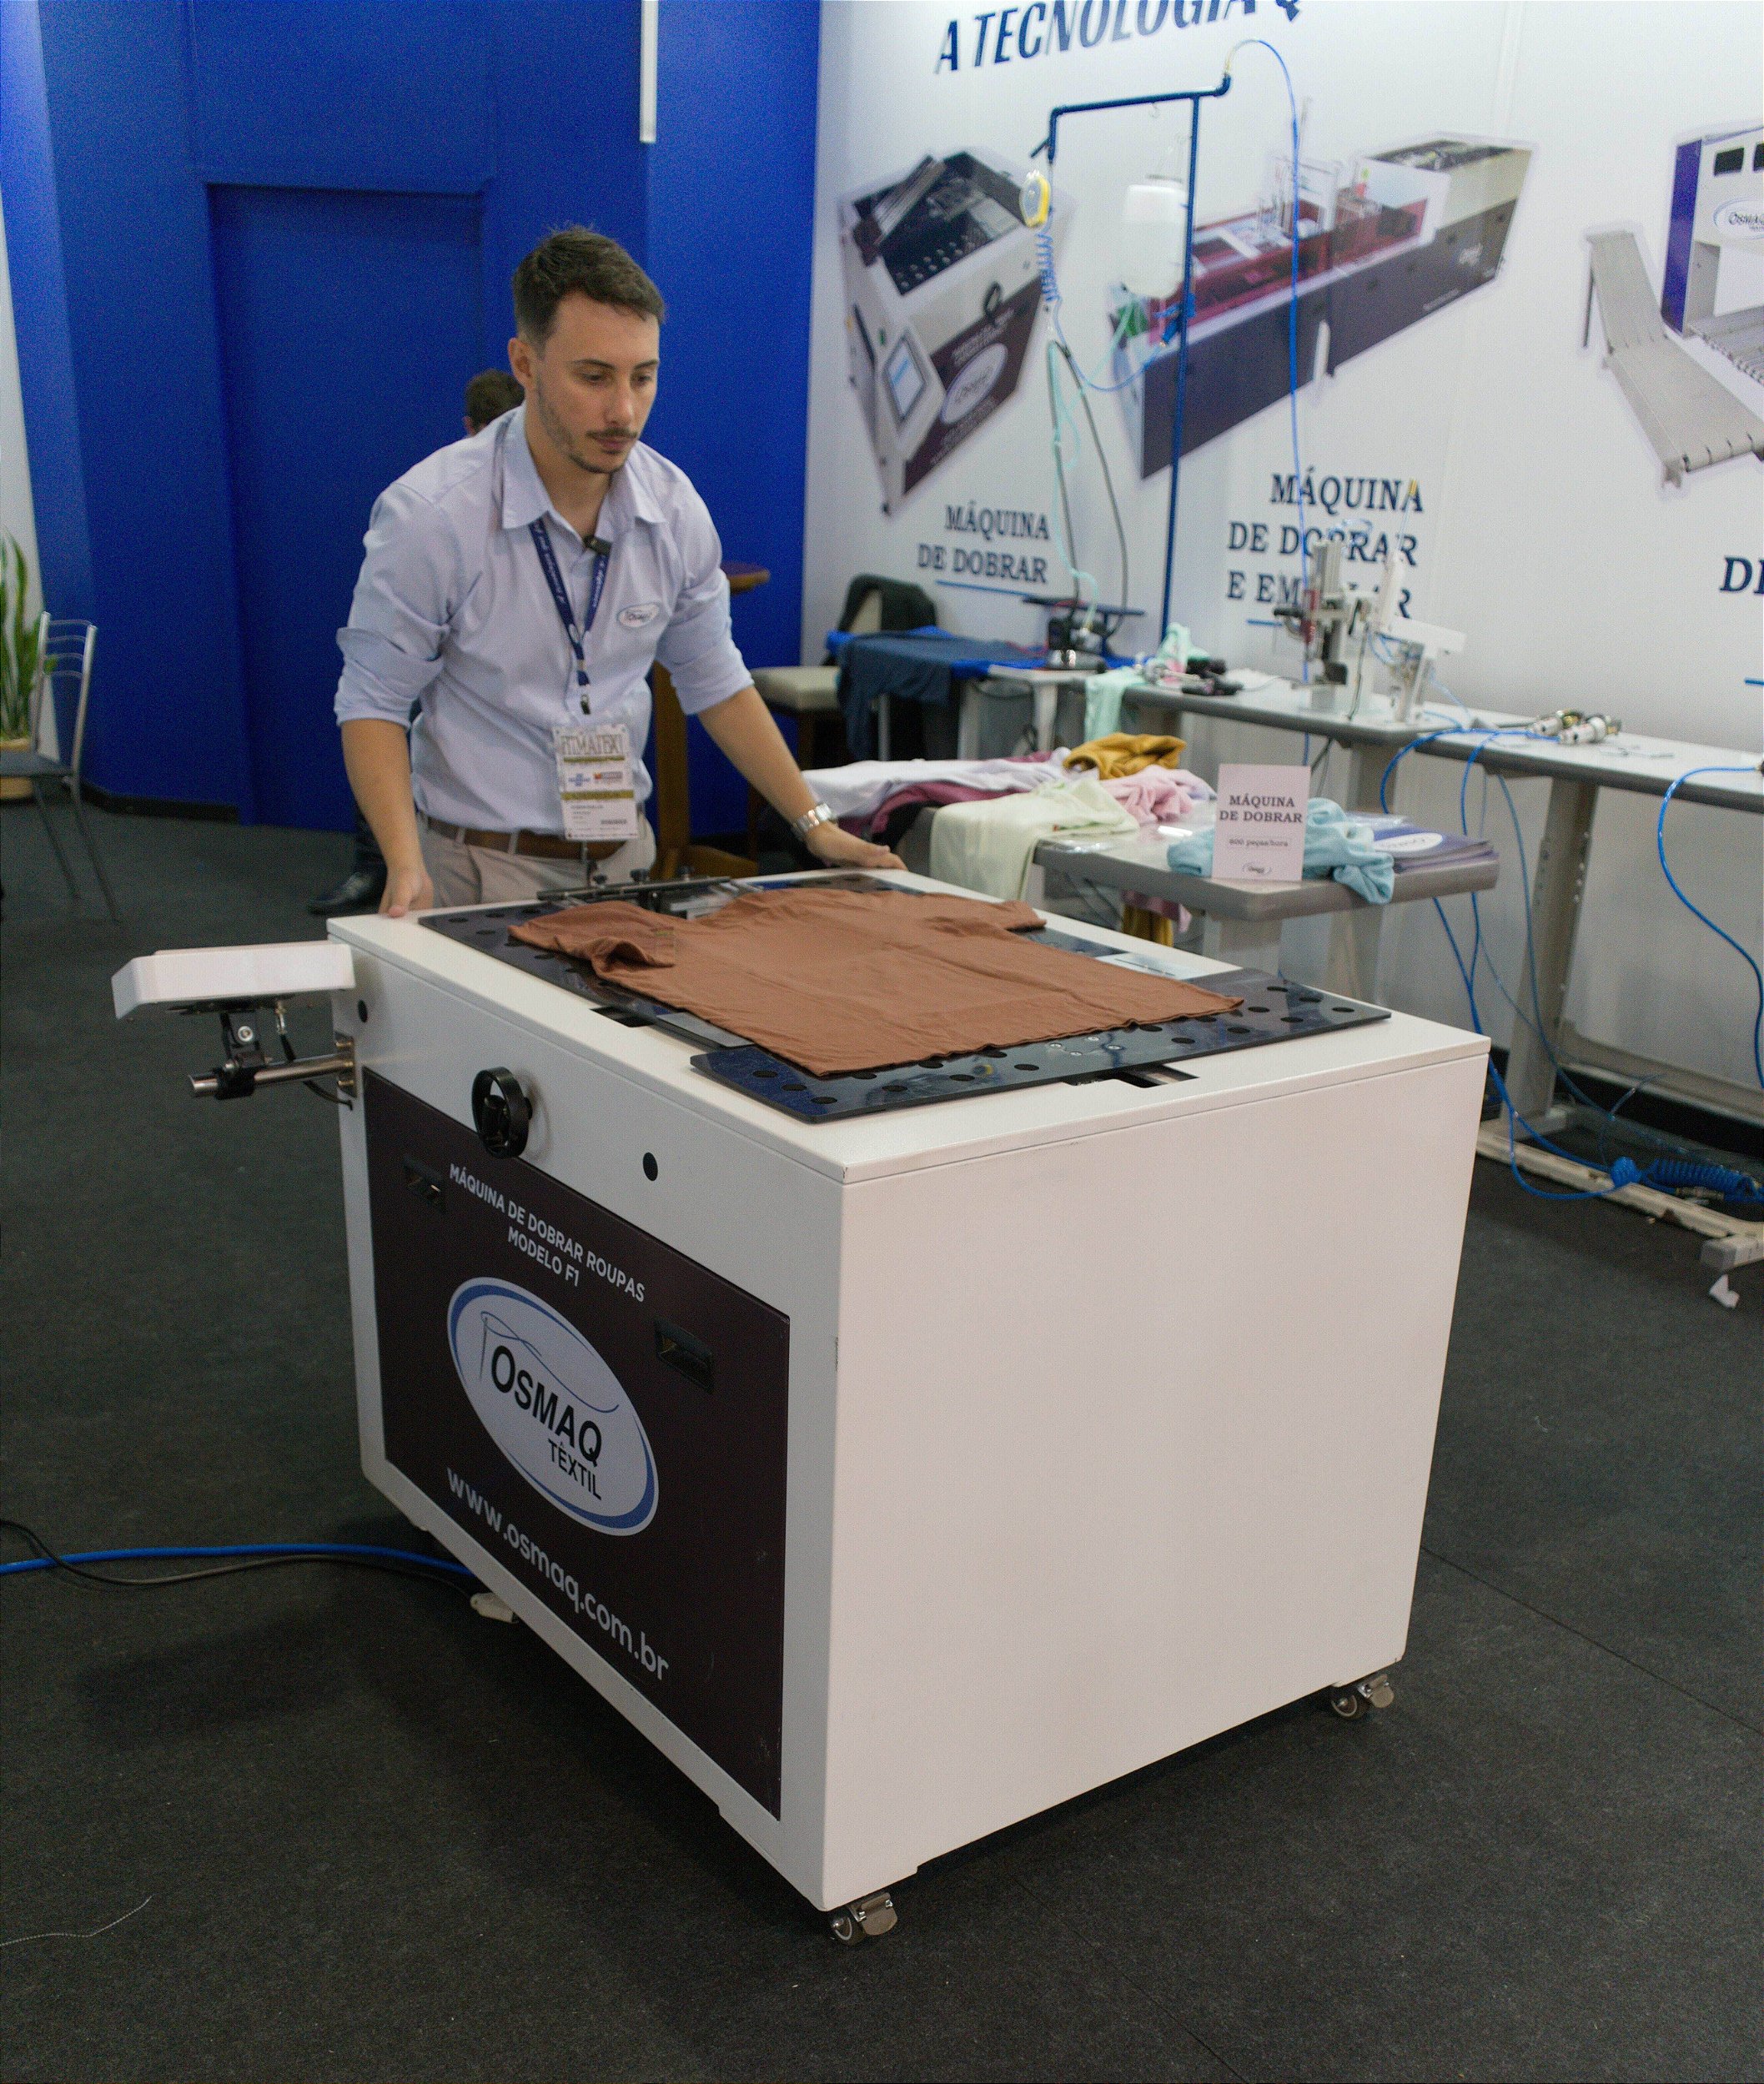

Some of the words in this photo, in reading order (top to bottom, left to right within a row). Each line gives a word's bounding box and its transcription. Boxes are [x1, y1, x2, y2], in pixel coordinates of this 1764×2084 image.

[933, 20, 957, 73] A
[1271, 466, 1423, 515] MÁQUINA
[945, 500, 1050, 540] MÁQUINA
[1228, 521, 1268, 552] DE
[918, 543, 945, 570] DE
[954, 548, 1048, 583] DOBRAR
[1228, 570, 1245, 599] E
[1219, 811, 1238, 821] DE
[1244, 811, 1303, 822] DOBRAR
[1229, 793, 1294, 808] MÁQUINA
[450, 1163, 505, 1213] MÁQUINA
[508, 1200, 525, 1225] DE
[528, 1213, 584, 1263] DOBRAR
[586, 1251, 646, 1303] ROUPAS
[508, 1227, 562, 1275] MODELO
[565, 1263, 580, 1287] F1
[490, 1345, 602, 1468] OSMAQ
[548, 1439, 601, 1500] TÊXTIL
[447, 1467, 669, 1680] www.osmaq.com.br
